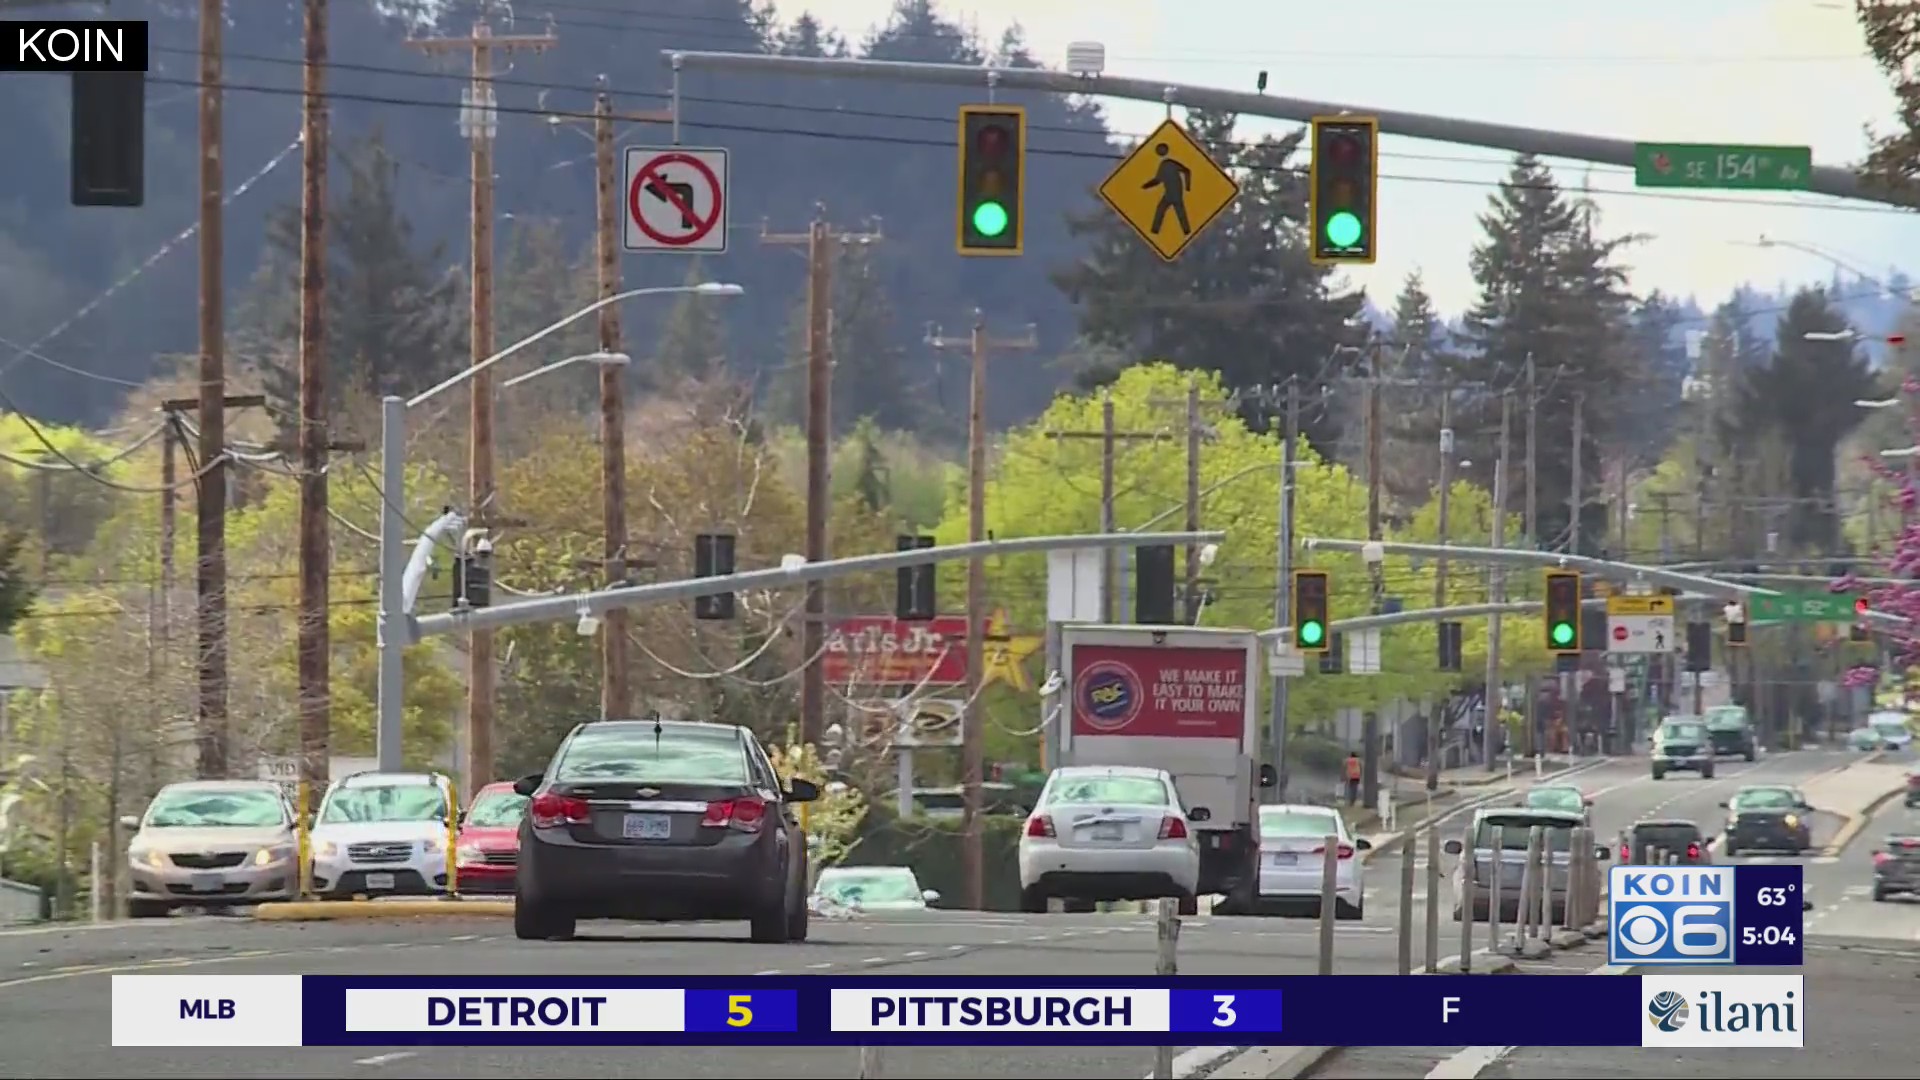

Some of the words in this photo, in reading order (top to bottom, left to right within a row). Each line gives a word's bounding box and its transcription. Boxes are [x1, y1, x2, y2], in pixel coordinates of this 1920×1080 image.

[1686, 160, 1706, 179] SE
[1159, 669, 1179, 683] WE
[1183, 669, 1222, 684] MAKE
[1225, 670, 1238, 684] IT
[1152, 683, 1183, 698] EASY
[1188, 684, 1204, 698] TO
[1207, 684, 1243, 699] MAKE
[1155, 698, 1167, 710] IT
[1172, 699, 1204, 713] YOUR
[1208, 700, 1241, 713] OWN
